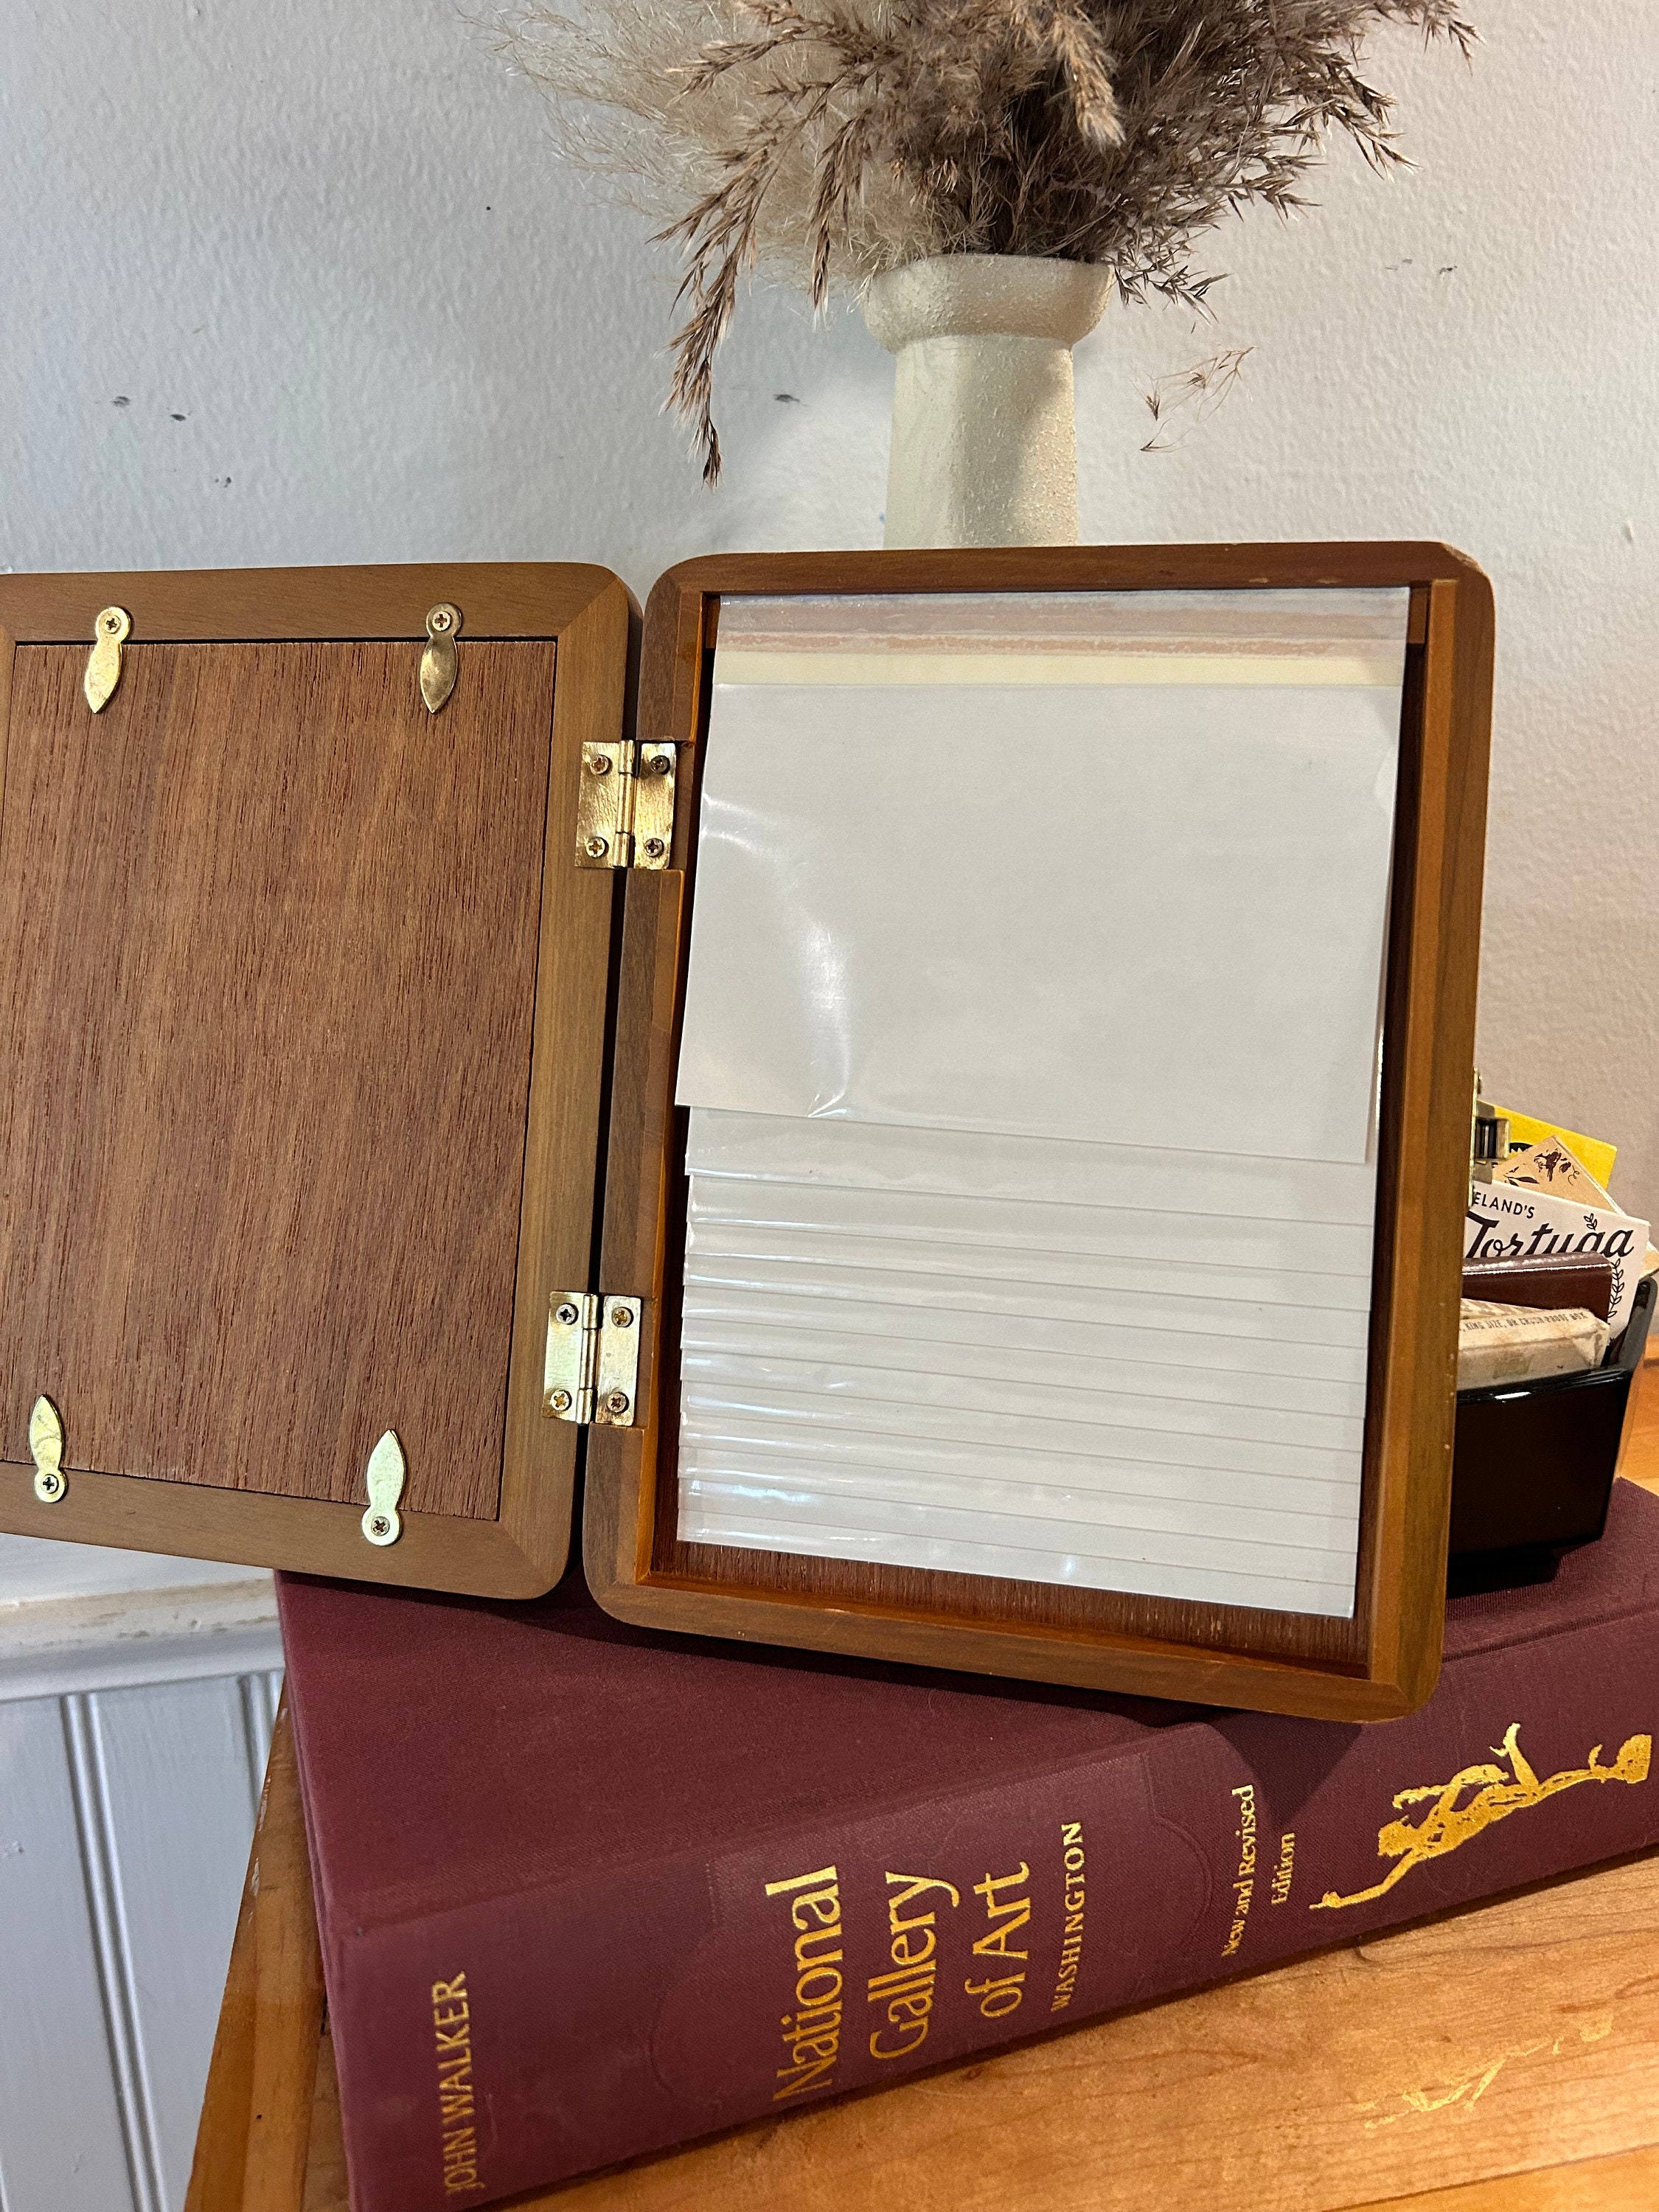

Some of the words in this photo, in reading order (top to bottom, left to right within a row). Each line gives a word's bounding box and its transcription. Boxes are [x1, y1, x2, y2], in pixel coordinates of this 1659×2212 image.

[1464, 1321, 1485, 1330] KING
[1569, 1312, 1588, 1321] BOX
[1231, 1784, 1256, 1877] Revised
[1271, 1832, 1295, 1905] Edition
[973, 1860, 1031, 1960] Art
[1050, 1821, 1085, 2012] WASHINGTON
[1221, 1919, 1246, 1956] New
[1232, 1879, 1253, 1916] and
[765, 1864, 843, 2101] National
[868, 1871, 960, 2059] Gallery
[965, 1971, 1026, 2018] of
[431, 1970, 475, 2125] WALKER
[442, 2126, 485, 2195] JOHN
